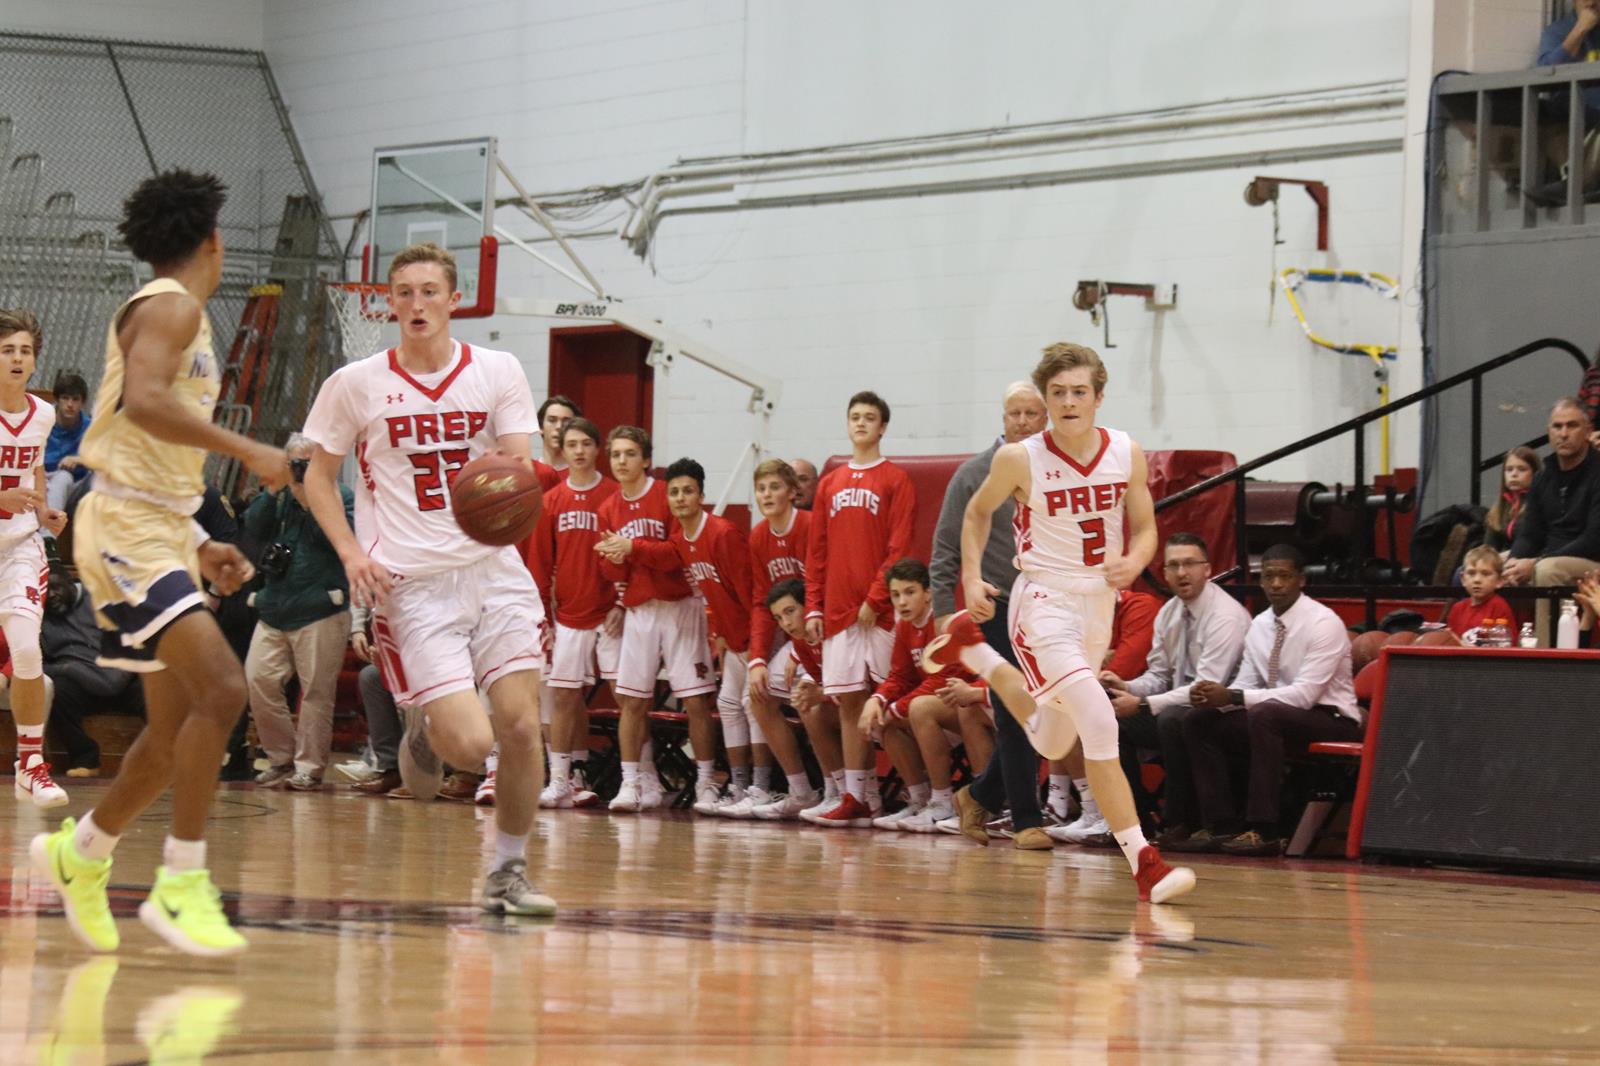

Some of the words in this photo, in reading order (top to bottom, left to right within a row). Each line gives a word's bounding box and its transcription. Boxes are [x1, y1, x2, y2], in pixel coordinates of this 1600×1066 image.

[384, 411, 488, 448] PREP
[0, 445, 40, 469] REP
[558, 510, 598, 532] ESUIT
[616, 518, 665, 540] ESUITS
[1077, 517, 1106, 567] 2
